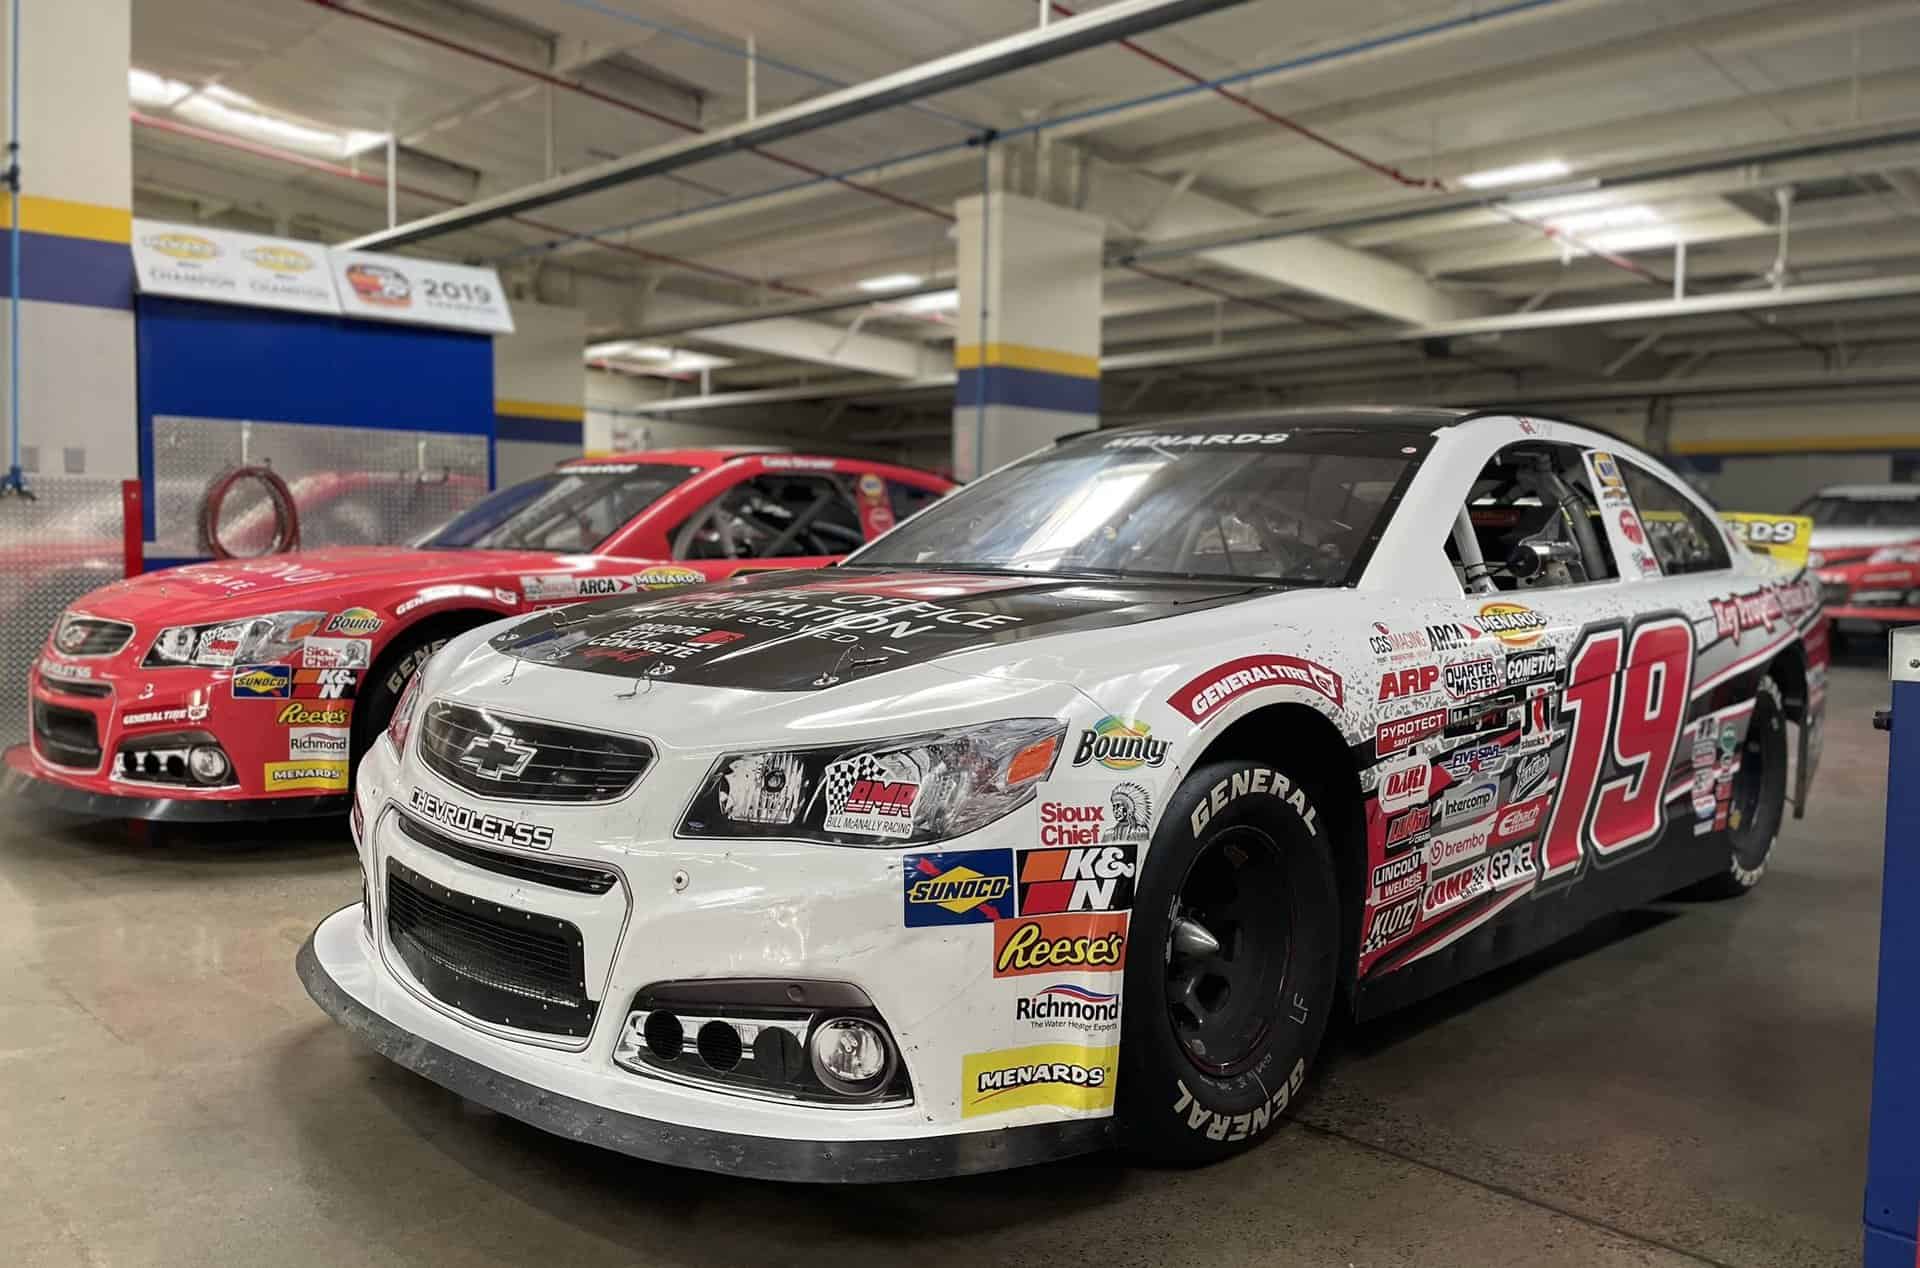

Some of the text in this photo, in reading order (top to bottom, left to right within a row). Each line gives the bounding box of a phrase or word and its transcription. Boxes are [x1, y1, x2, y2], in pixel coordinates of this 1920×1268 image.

[423, 278, 492, 304] 2019
[579, 578, 616, 595] ARCA
[634, 573, 706, 586] MENARDS
[325, 614, 384, 634] Bounty
[832, 594, 1023, 630] OFFICE
[1474, 609, 1548, 634] MENARDS
[631, 622, 712, 636] BRIDGE
[1425, 623, 1469, 652] ARCA
[588, 637, 704, 658] CONCRETE
[1369, 635, 1392, 654] CGS
[305, 657, 334, 668] Chief
[1507, 652, 1556, 679] COMETIC
[237, 676, 288, 688] SUNOCO
[1378, 665, 1440, 701] ARP
[1444, 661, 1495, 689] QUARTER
[1456, 675, 1499, 698] MASTER
[1191, 664, 1313, 716] GENERAL TIRE
[122, 709, 187, 725] GENERAL TIRE
[278, 702, 348, 724] Reese's
[1379, 713, 1444, 740] PYROTECT
[291, 736, 347, 750] Richmond
[1072, 728, 1171, 769] Bounty
[1542, 616, 1694, 880] 19
[1452, 751, 1478, 769] FIVE
[272, 768, 341, 781] MENARDS
[1040, 802, 1105, 823] Sioux
[1190, 767, 1318, 840] GENERAL
[1445, 793, 1491, 816] Intercomp
[826, 814, 842, 829] BILL
[883, 821, 912, 836] RACING
[1040, 825, 1100, 846] Chief
[1445, 832, 1486, 854] brembo
[910, 876, 1009, 902] SUNOCO
[1383, 870, 1423, 898] WELDERS
[1424, 867, 1474, 910] COMP
[1370, 900, 1418, 938] KLOTZ
[997, 923, 1124, 972] Reese's
[1016, 993, 1119, 1021] Richmond
[1031, 1020, 1118, 1033] The Water Heater Experts
[977, 1062, 1105, 1093] MENARDS
[1172, 1056, 1306, 1142] GENERAL
